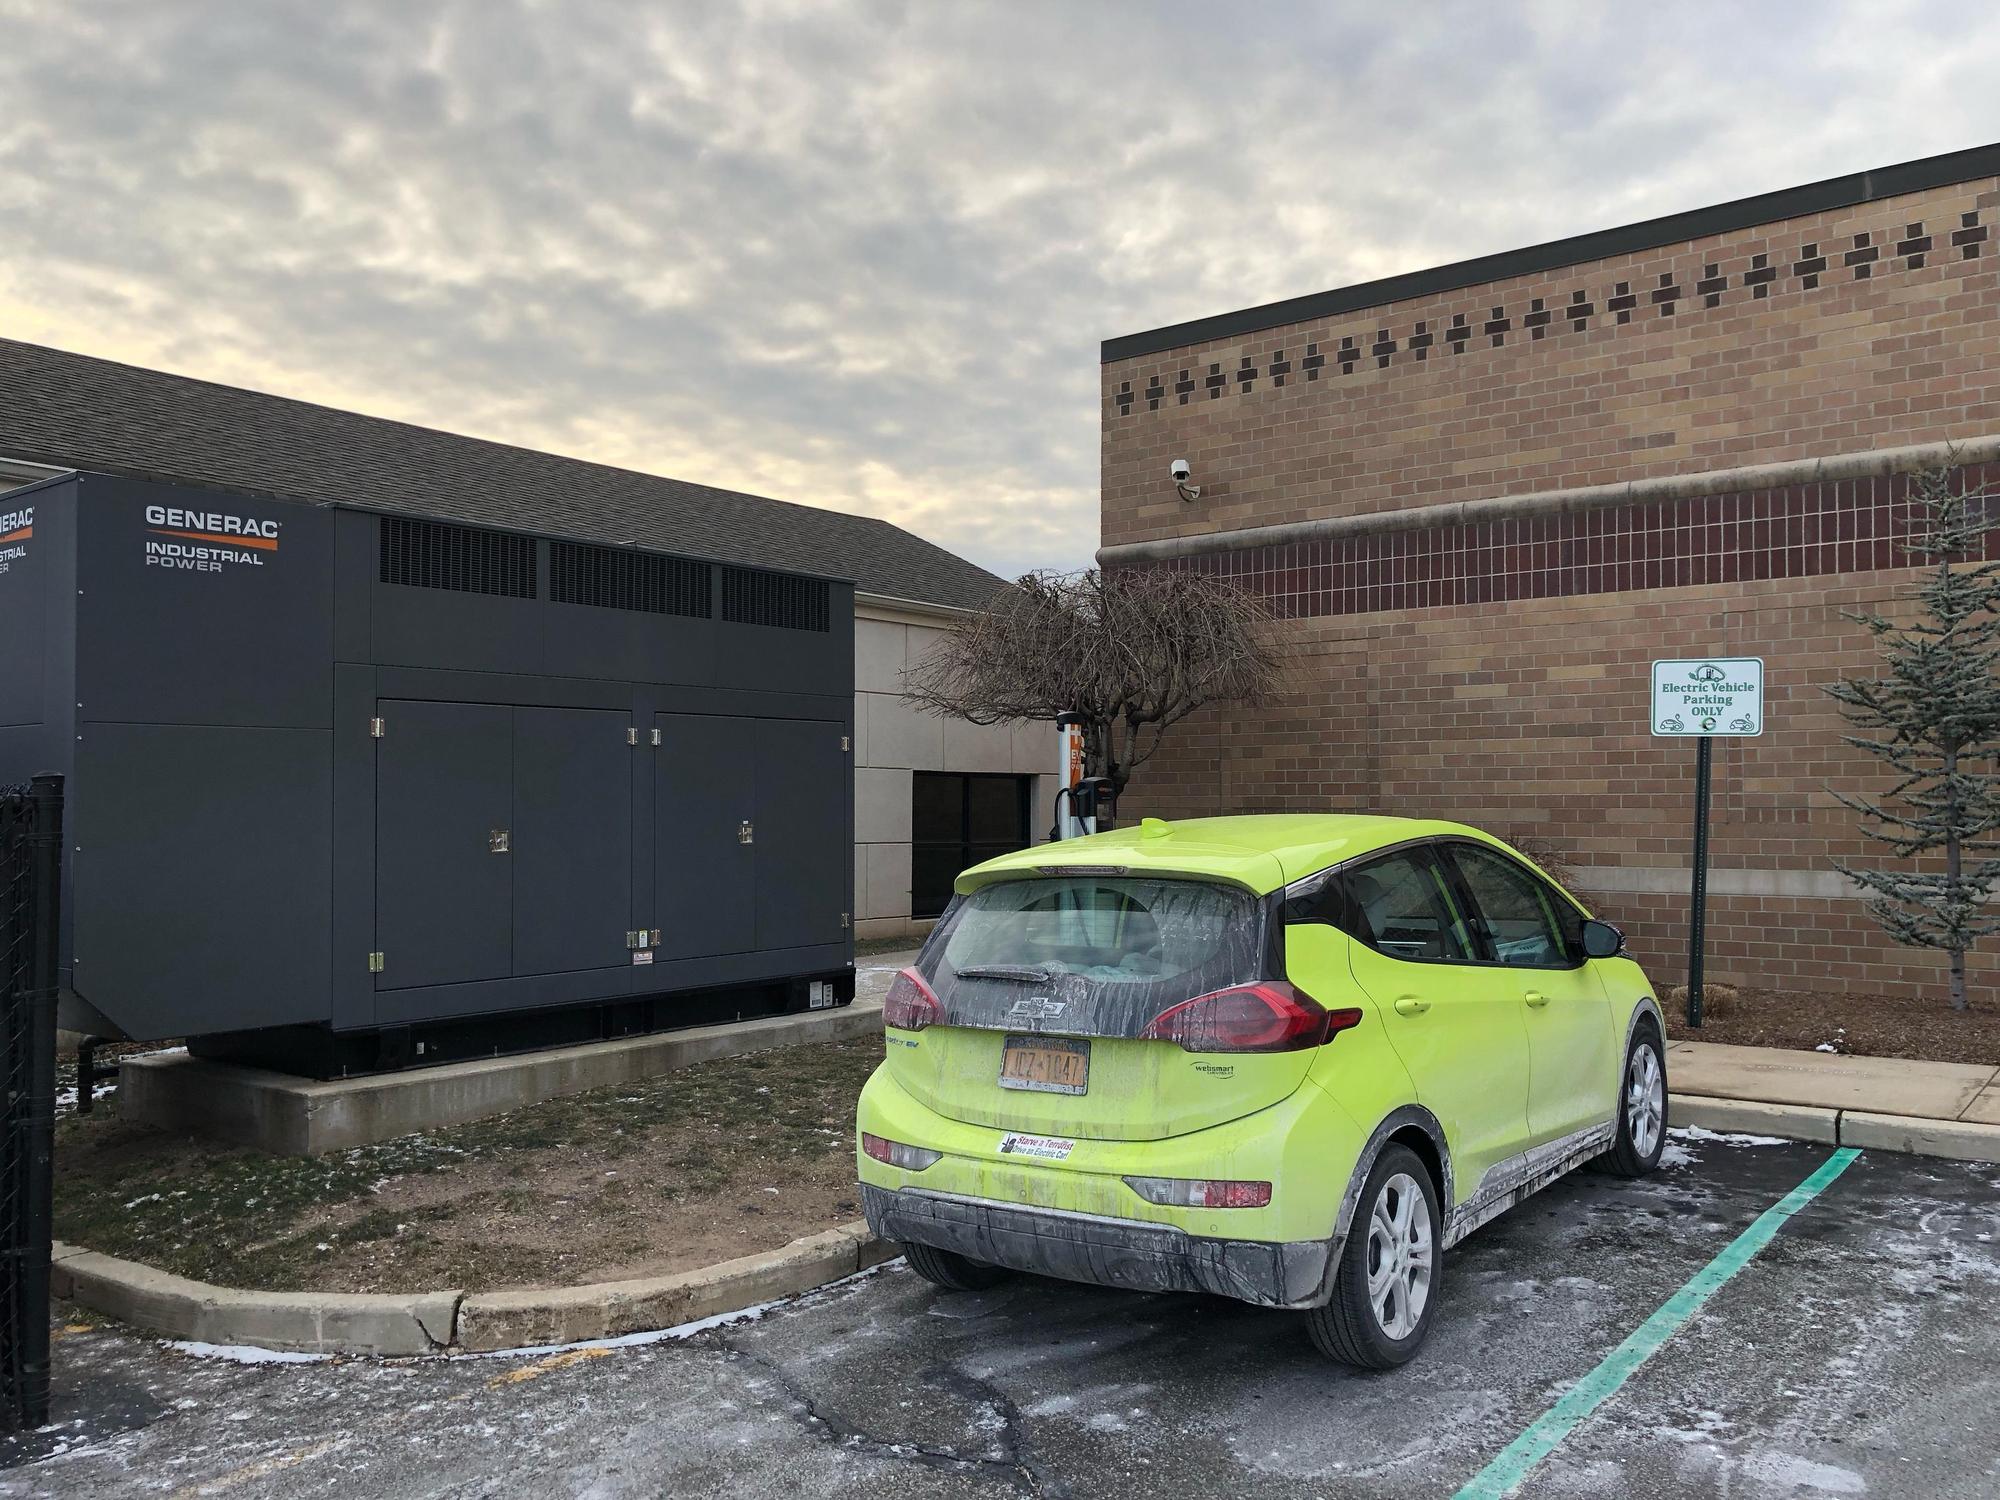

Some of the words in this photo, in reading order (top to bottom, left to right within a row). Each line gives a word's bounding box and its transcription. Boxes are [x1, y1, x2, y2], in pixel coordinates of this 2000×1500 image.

[0, 507, 33, 533] ERAC
[145, 505, 278, 538] GENERAC
[146, 542, 263, 565] INDUSTRIAL
[146, 555, 222, 573] POWER
[1662, 683, 1708, 693] Electric
[1711, 682, 1755, 692] Vehicle
[1683, 695, 1733, 706] Parking
[1691, 707, 1724, 716] ONLY
[1017, 1136, 1039, 1146] Starve
[1045, 1139, 1074, 1151] Terrorist
